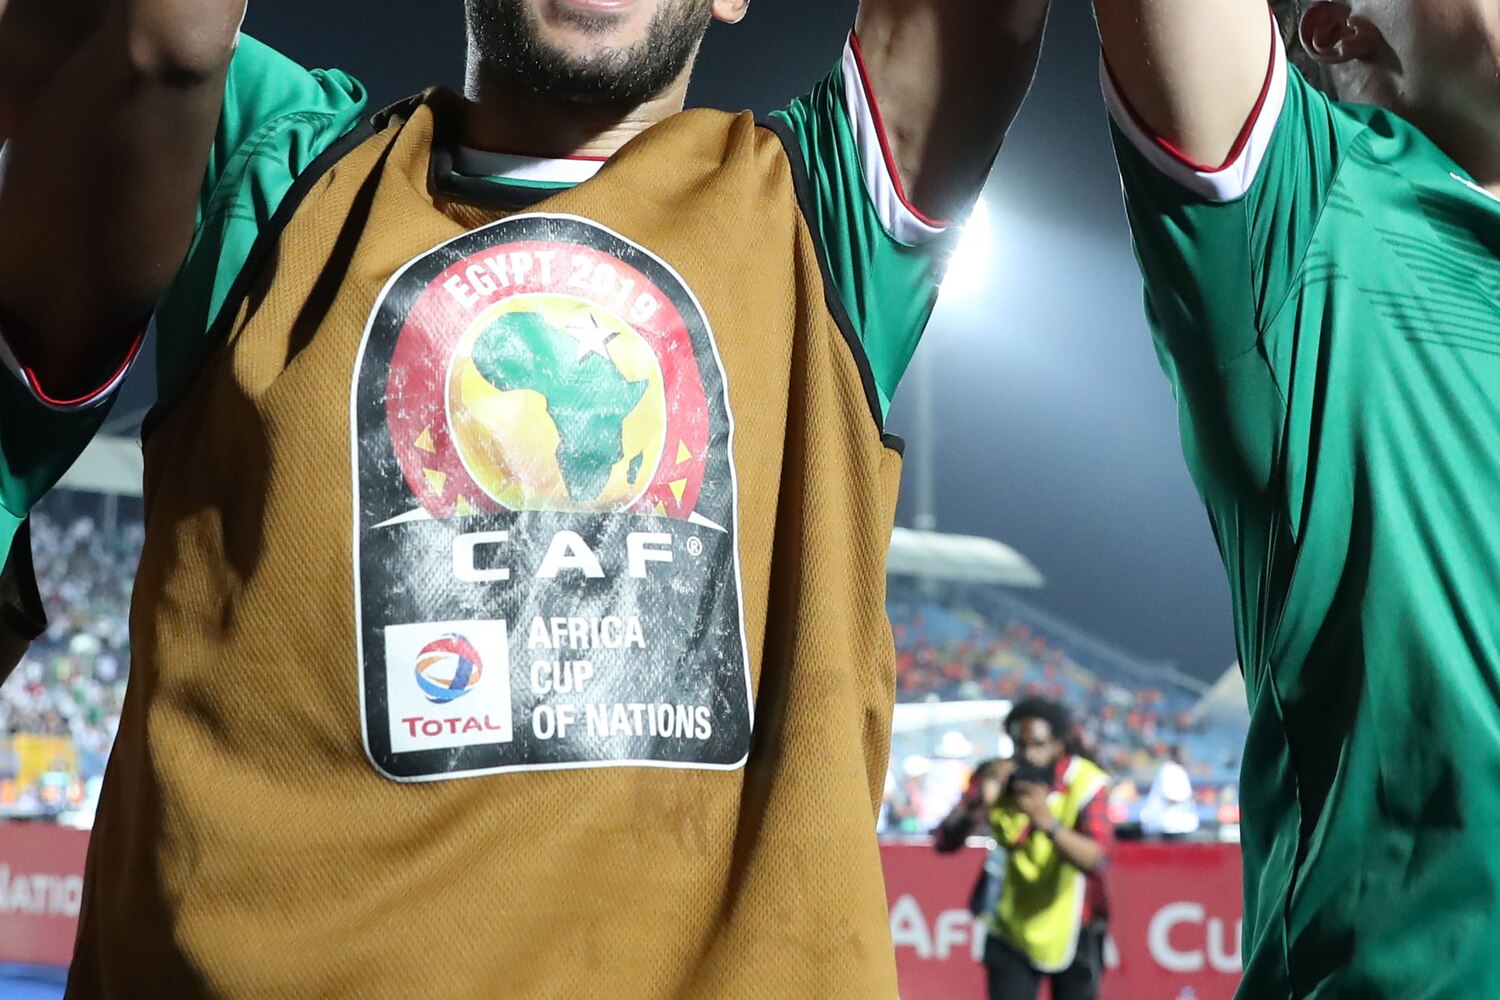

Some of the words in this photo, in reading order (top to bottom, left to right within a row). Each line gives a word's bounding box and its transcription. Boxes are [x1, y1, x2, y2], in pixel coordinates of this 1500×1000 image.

[442, 249, 556, 309] EGYPT
[567, 255, 660, 323] 2019
[452, 530, 673, 582] CAF
[528, 615, 647, 651] AFRICA
[530, 659, 594, 694] CUP
[401, 715, 501, 738] TOTAL
[532, 703, 575, 740] OF
[587, 702, 712, 740] NATIONS
[1147, 901, 1243, 973] CU
